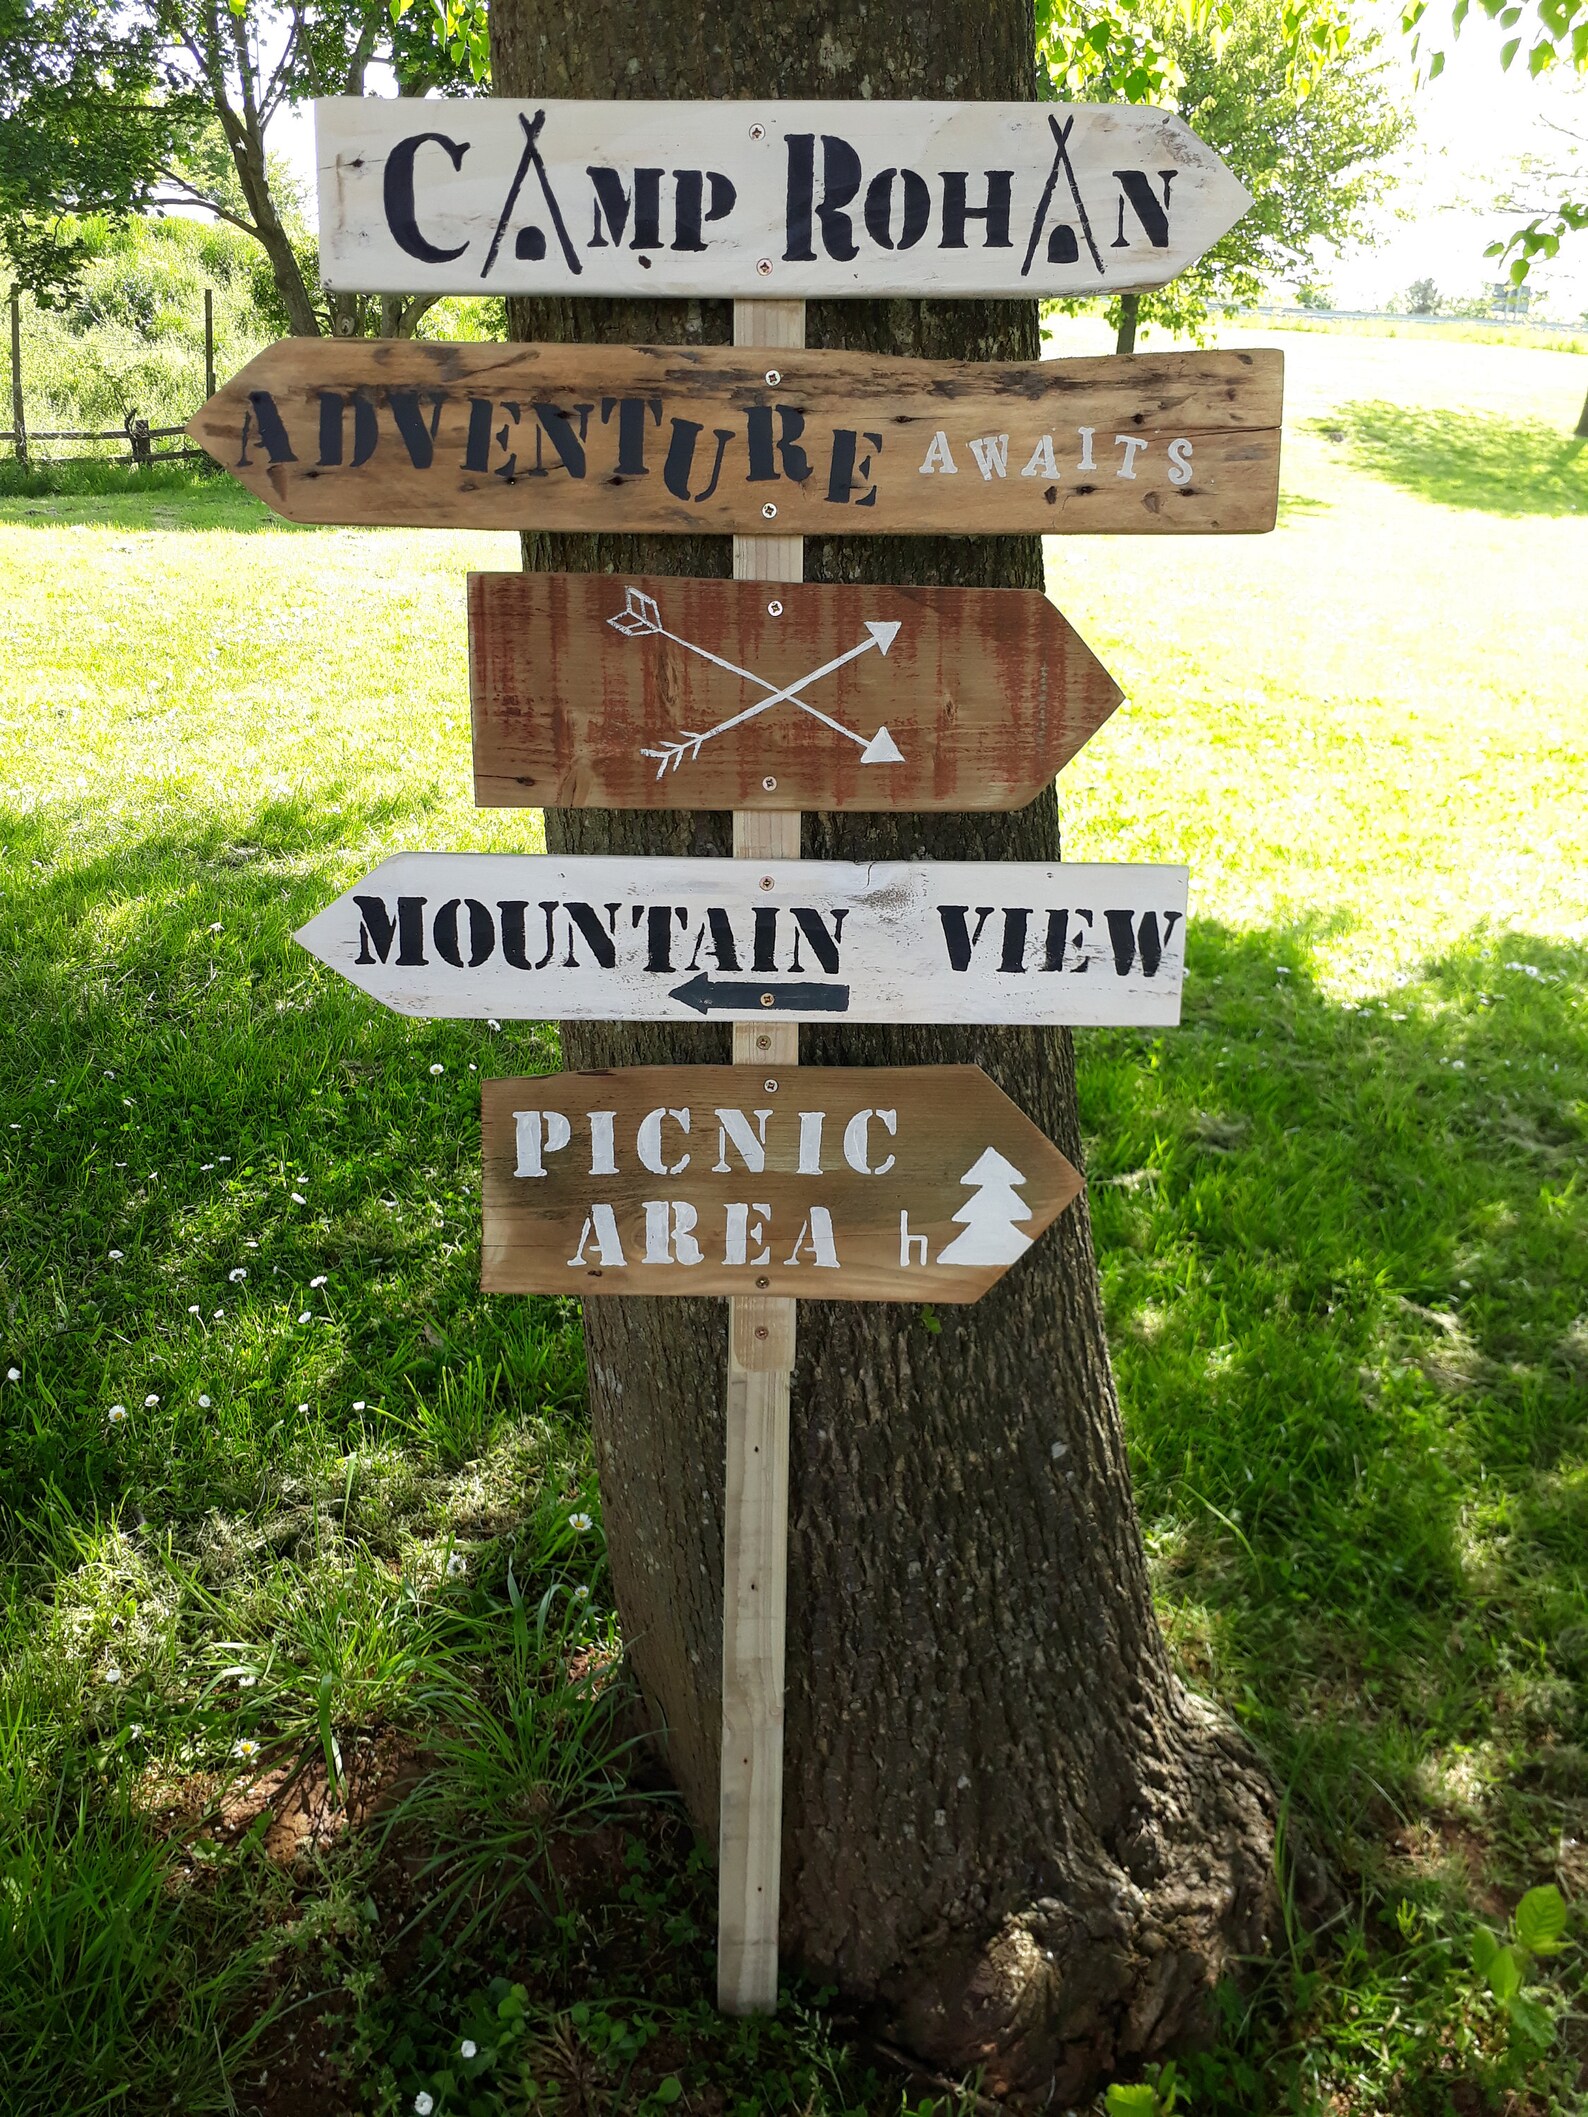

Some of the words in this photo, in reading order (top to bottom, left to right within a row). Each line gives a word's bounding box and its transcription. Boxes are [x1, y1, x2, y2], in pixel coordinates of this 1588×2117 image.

[383, 108, 737, 278] CAMP
[780, 112, 1179, 277] ROHAN
[235, 389, 884, 506] ADVENTURE
[918, 425, 1196, 486] AWAITS
[352, 894, 850, 975] MOUNTAIN
[936, 904, 1184, 978] VIEW
[512, 1106, 898, 1179] PICNIC
[566, 1200, 842, 1269] AREA
